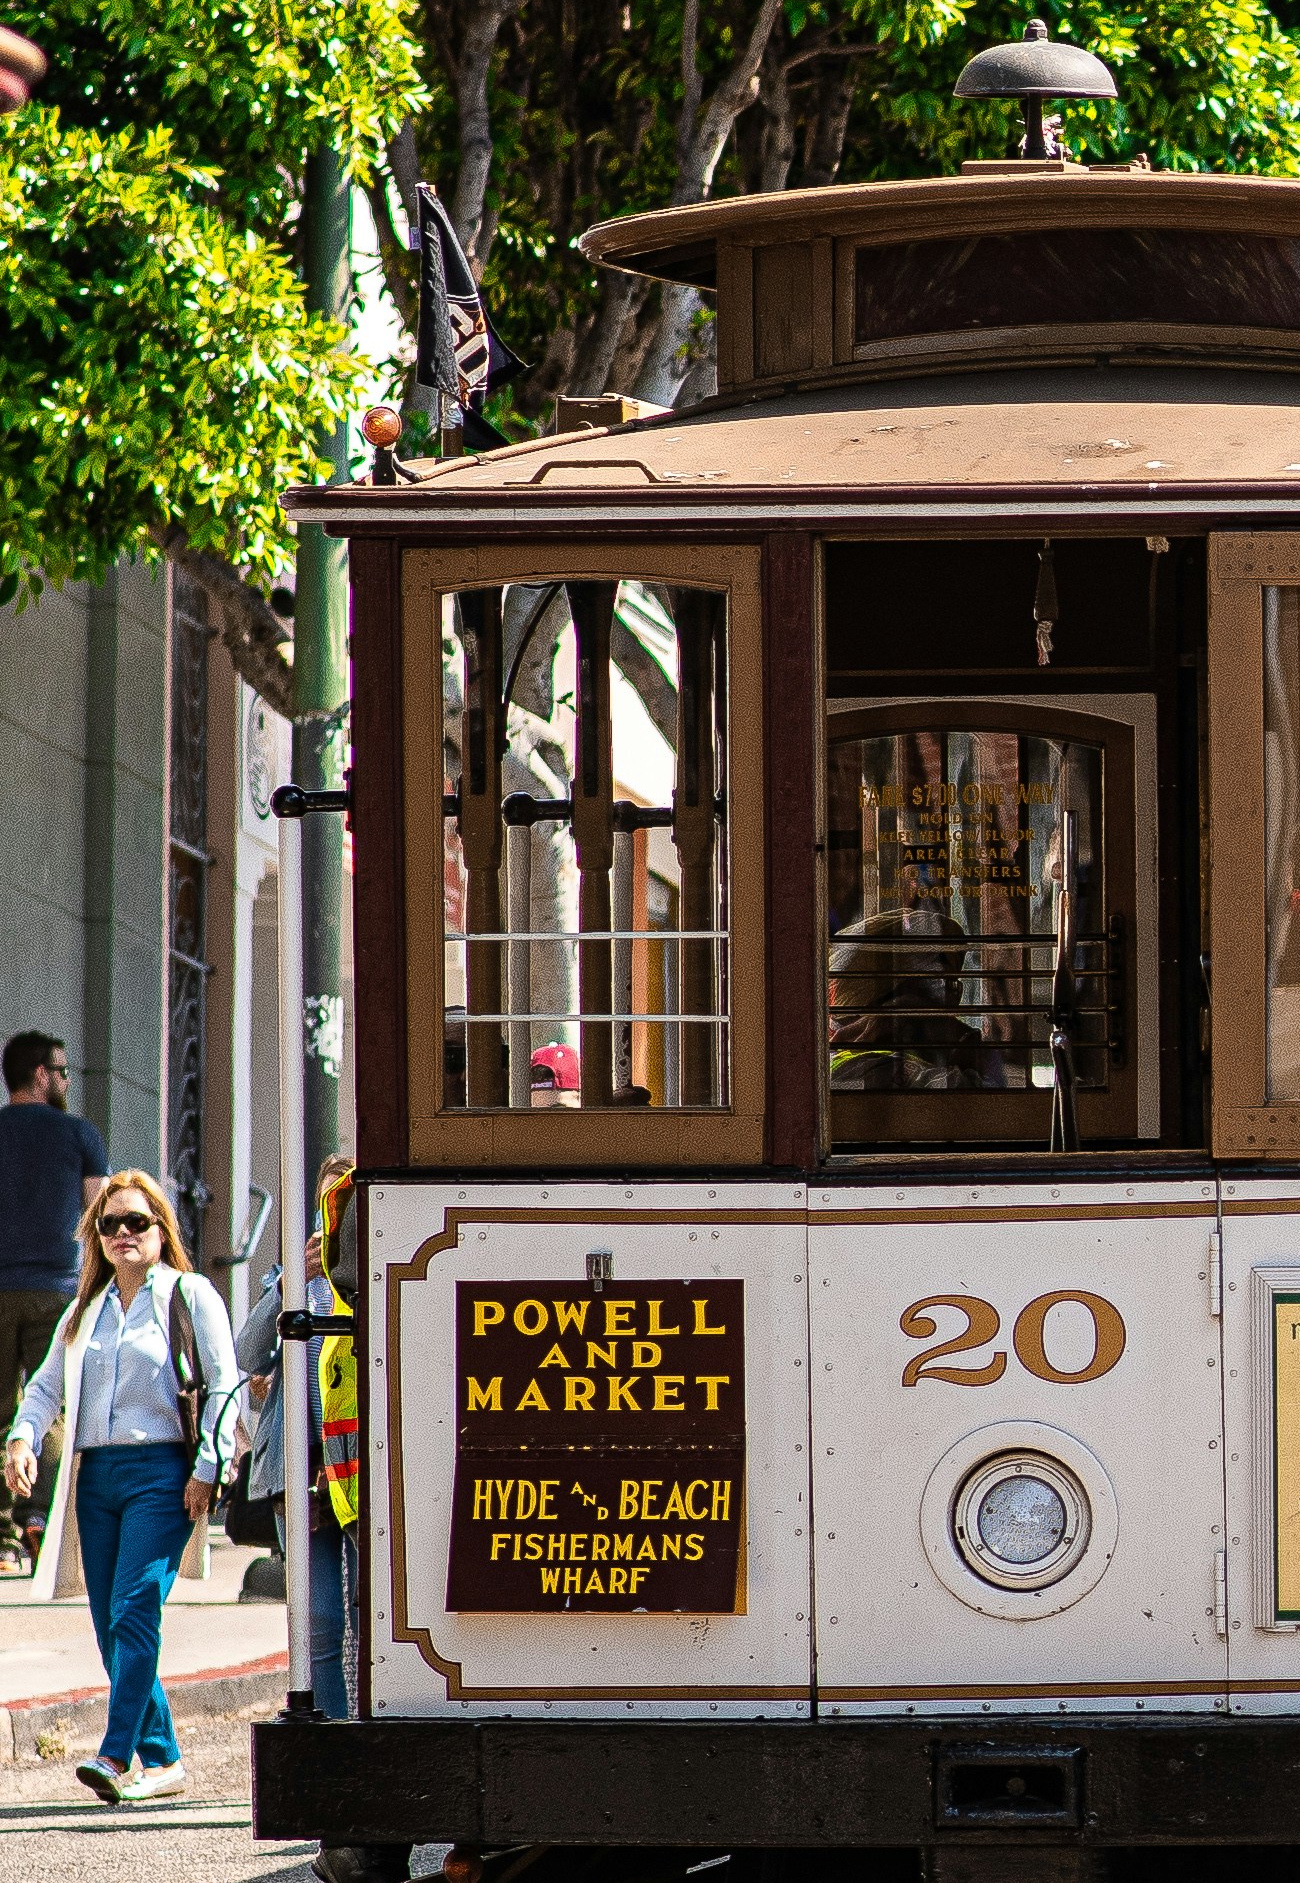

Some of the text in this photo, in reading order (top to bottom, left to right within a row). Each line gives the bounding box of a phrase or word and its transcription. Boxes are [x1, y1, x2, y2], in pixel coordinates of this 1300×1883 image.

[472, 1299, 726, 1336] POWELL
[538, 1341, 662, 1368] AND
[899, 1289, 1127, 1387] 20
[466, 1375, 730, 1411] MARKET
[472, 1479, 732, 1521] HYDE AND BEACH
[489, 1533, 705, 1561] FISHERMANS
[540, 1567, 650, 1594] WHARF
